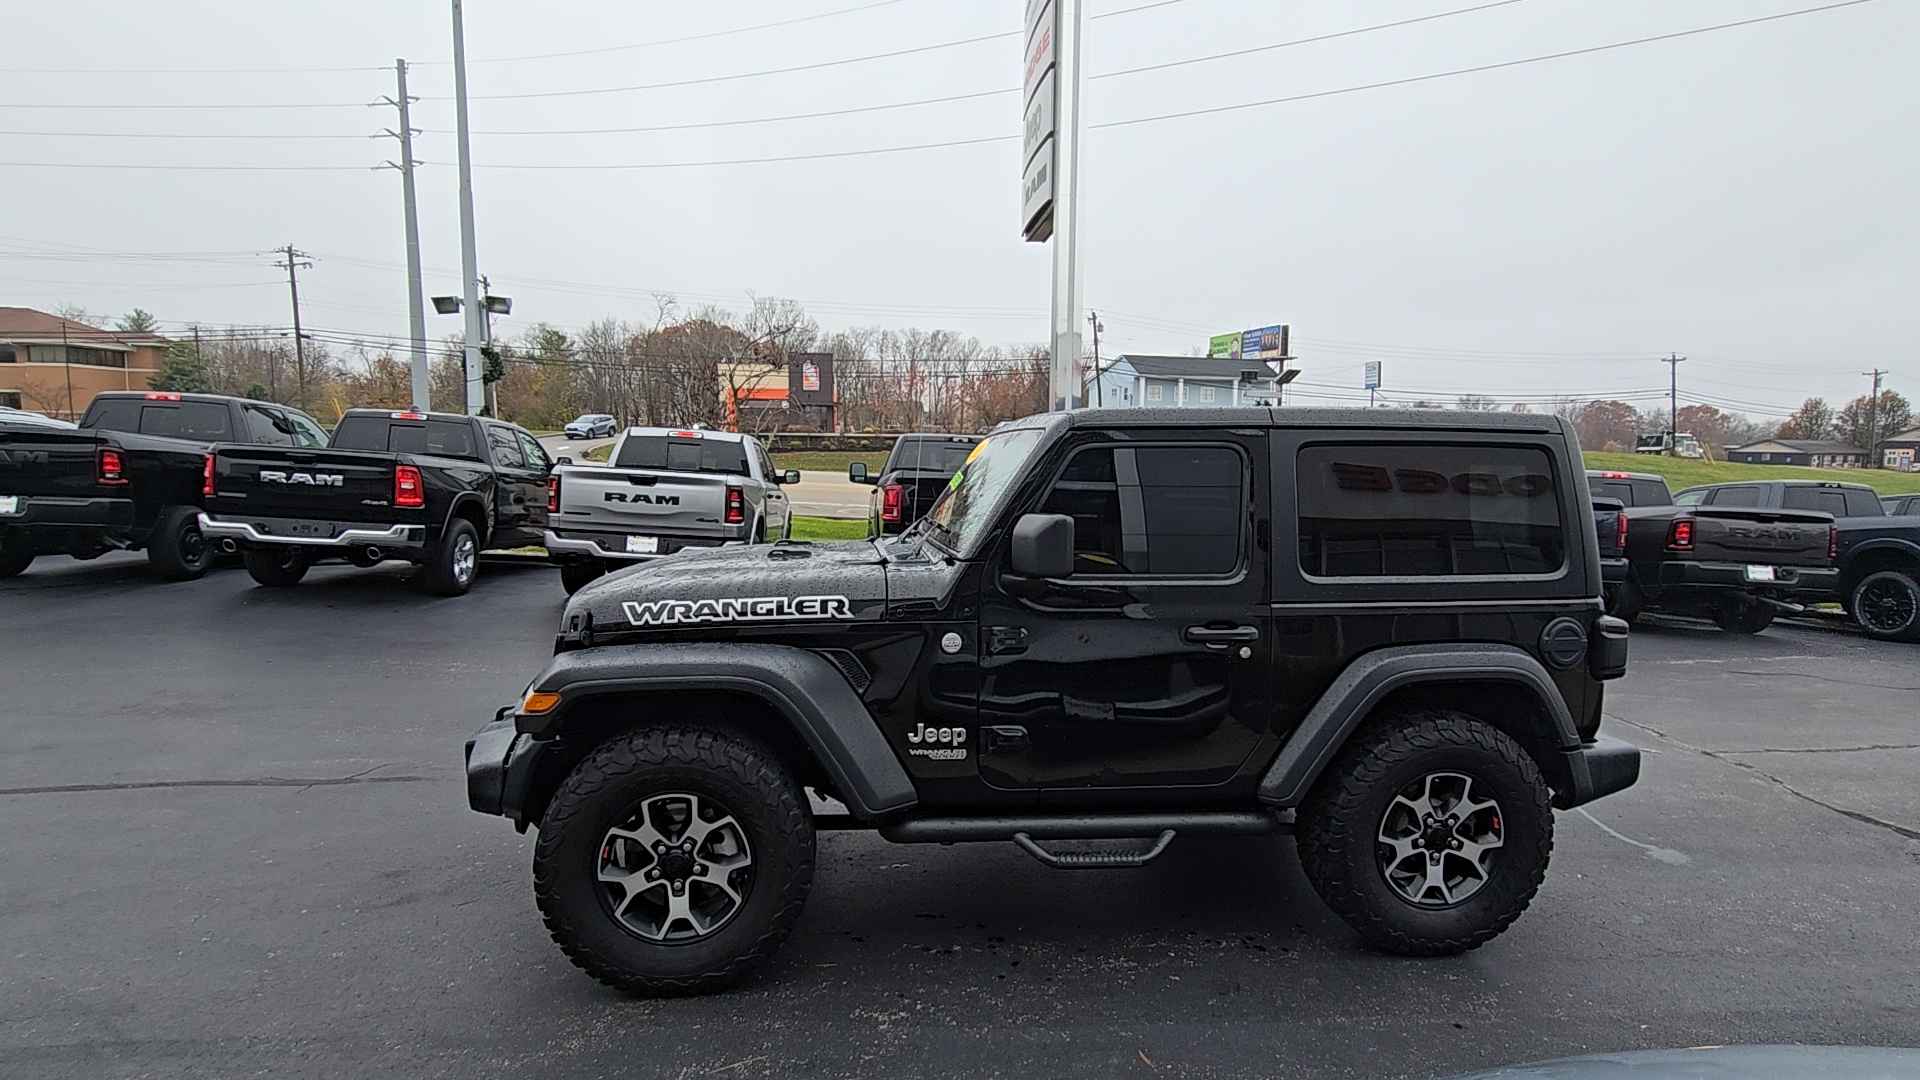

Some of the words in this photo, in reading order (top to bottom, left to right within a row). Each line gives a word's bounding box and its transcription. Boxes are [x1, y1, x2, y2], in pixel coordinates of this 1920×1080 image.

[1025, 163, 1048, 206] RAM
[260, 471, 344, 487] RAM
[604, 492, 680, 505] RAM
[1728, 526, 1803, 540] RAM
[622, 595, 855, 626] WRANGLER
[907, 722, 967, 747] Jeep
